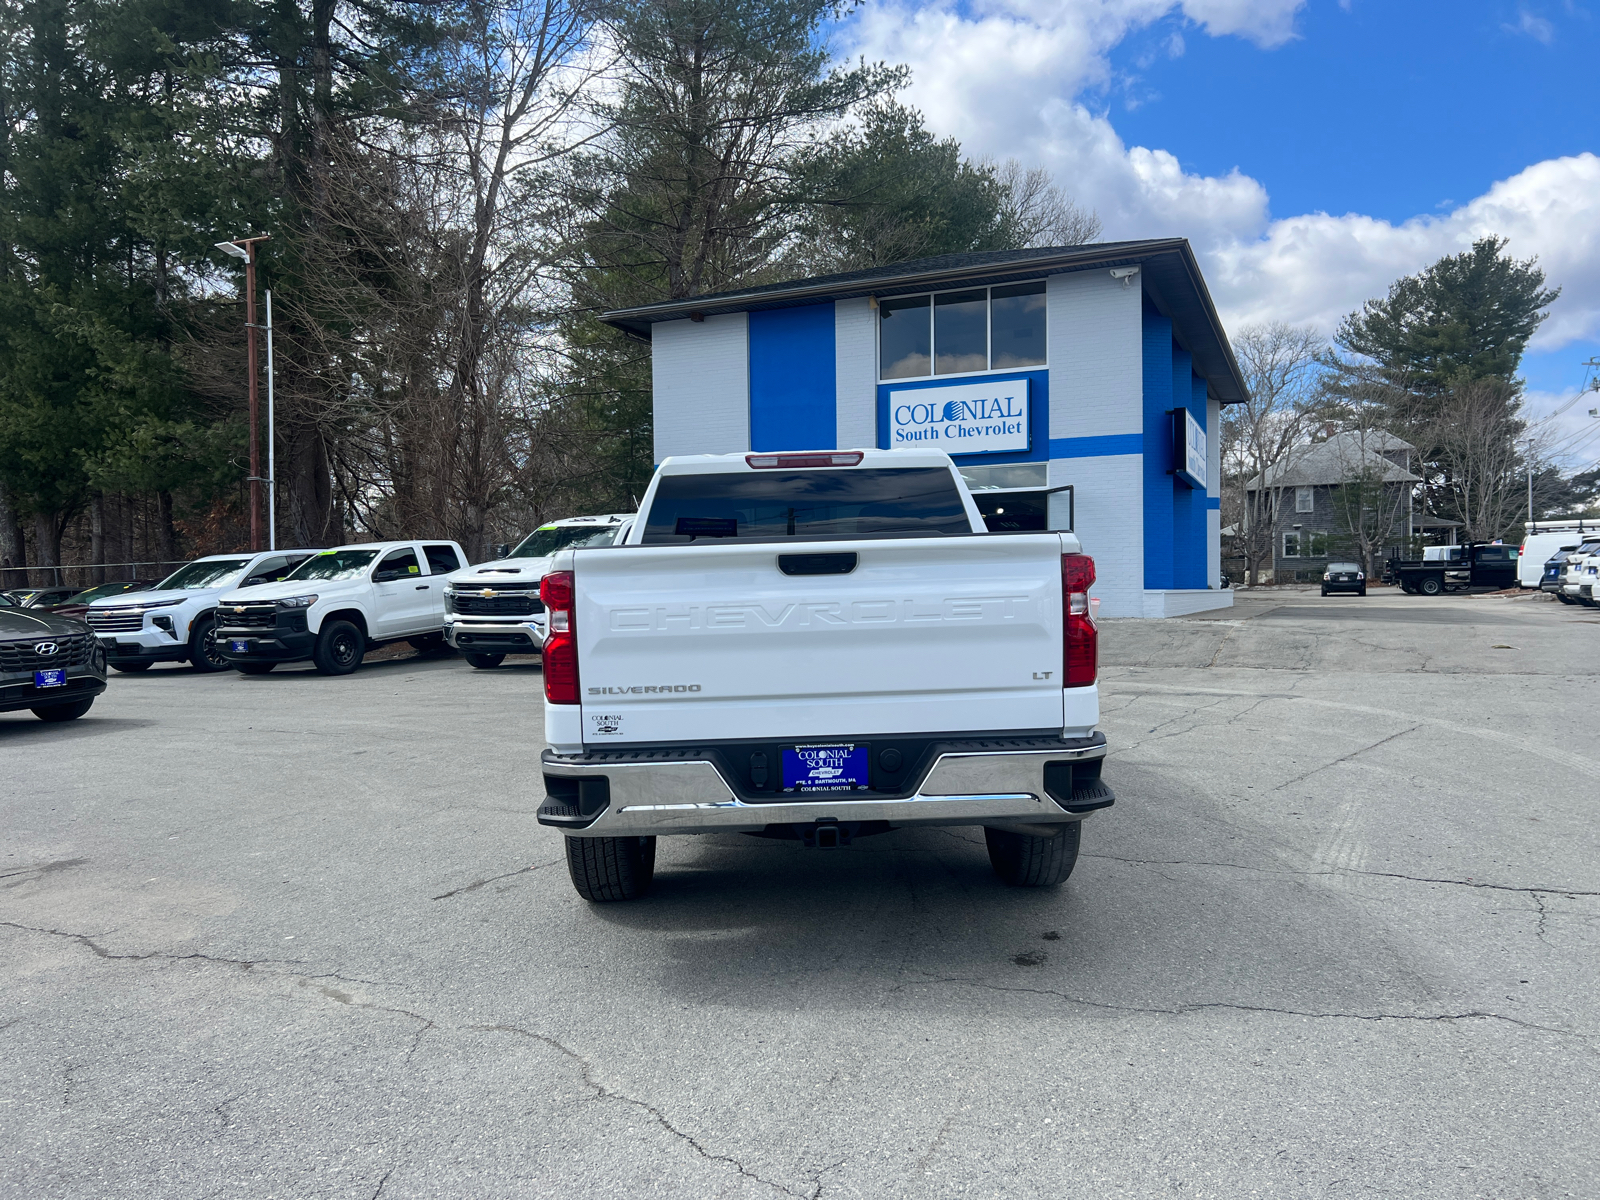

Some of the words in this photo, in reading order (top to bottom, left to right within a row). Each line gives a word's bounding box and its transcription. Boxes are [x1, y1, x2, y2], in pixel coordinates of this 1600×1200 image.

[894, 396, 1023, 426] COLONIAL
[895, 426, 939, 442] South
[944, 420, 1022, 439] Chevrolet
[609, 595, 1030, 632] CHEVROLET
[1032, 671, 1053, 680] LT
[588, 684, 702, 695] SILVERADO
[798, 750, 851, 760] COLONIAL
[806, 758, 843, 768] SOUTH
